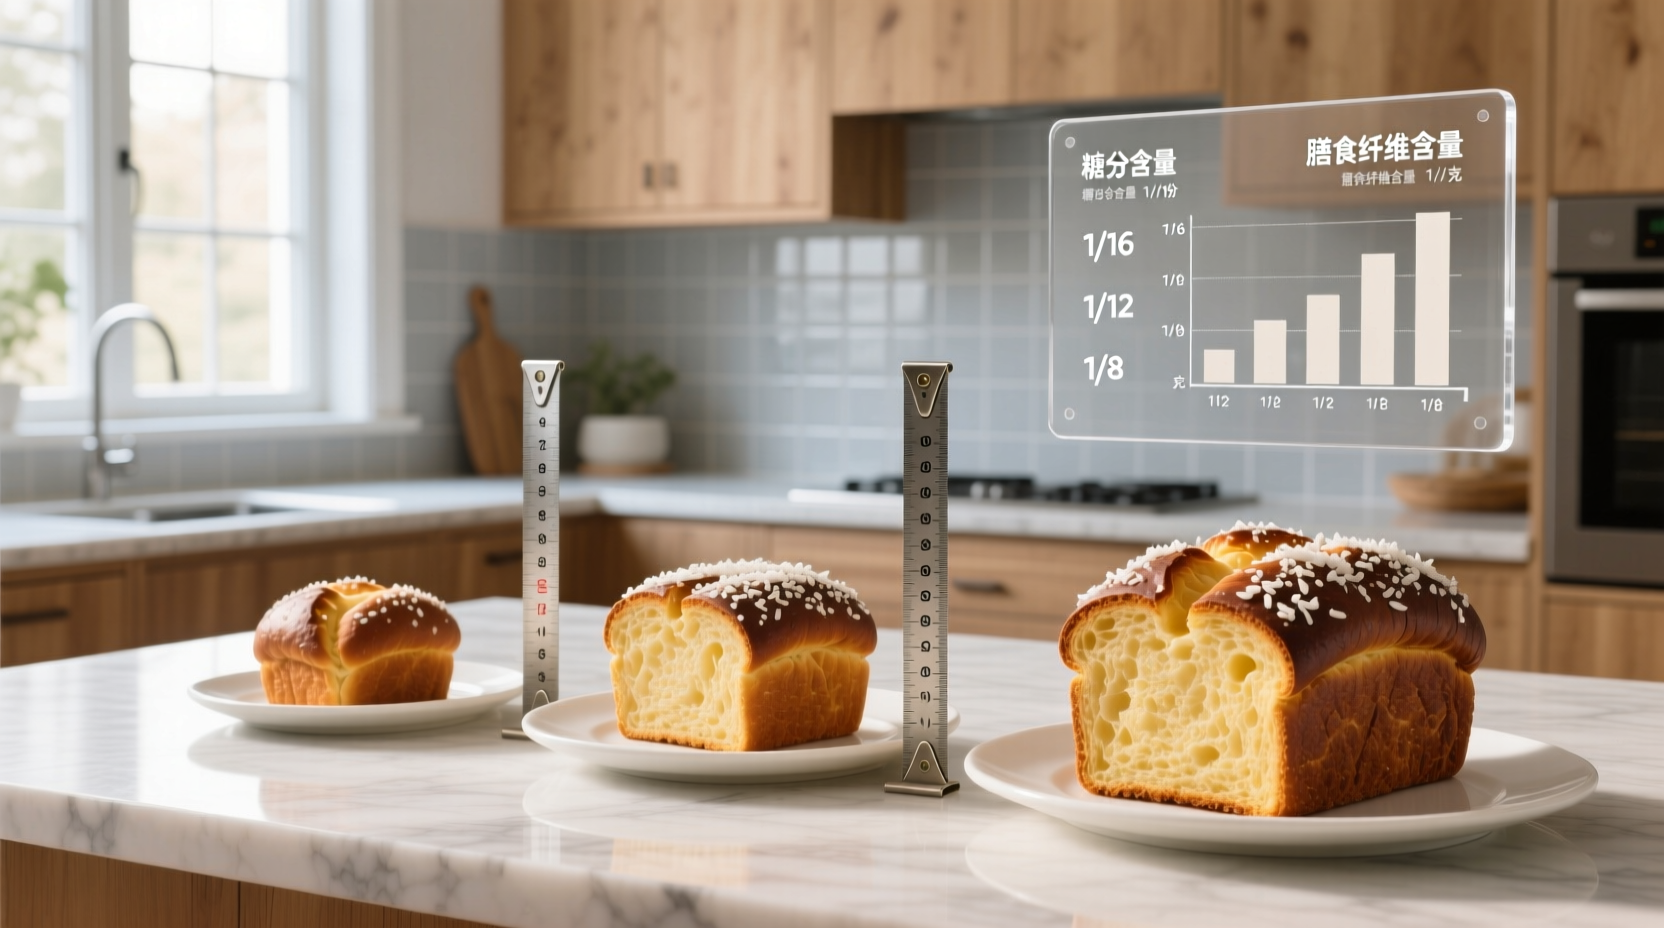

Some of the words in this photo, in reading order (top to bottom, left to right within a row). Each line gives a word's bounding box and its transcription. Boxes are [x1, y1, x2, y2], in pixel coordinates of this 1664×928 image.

[1081, 148, 1177, 180] 糖分含量
[1306, 130, 1464, 167] 膳食纤维含量
[1162, 222, 1186, 236] 1/6
[1083, 230, 1135, 263] 1/16
[1083, 292, 1134, 325] 1/12
[1083, 354, 1124, 387] 1/8
[1312, 396, 1334, 410] 1/2
